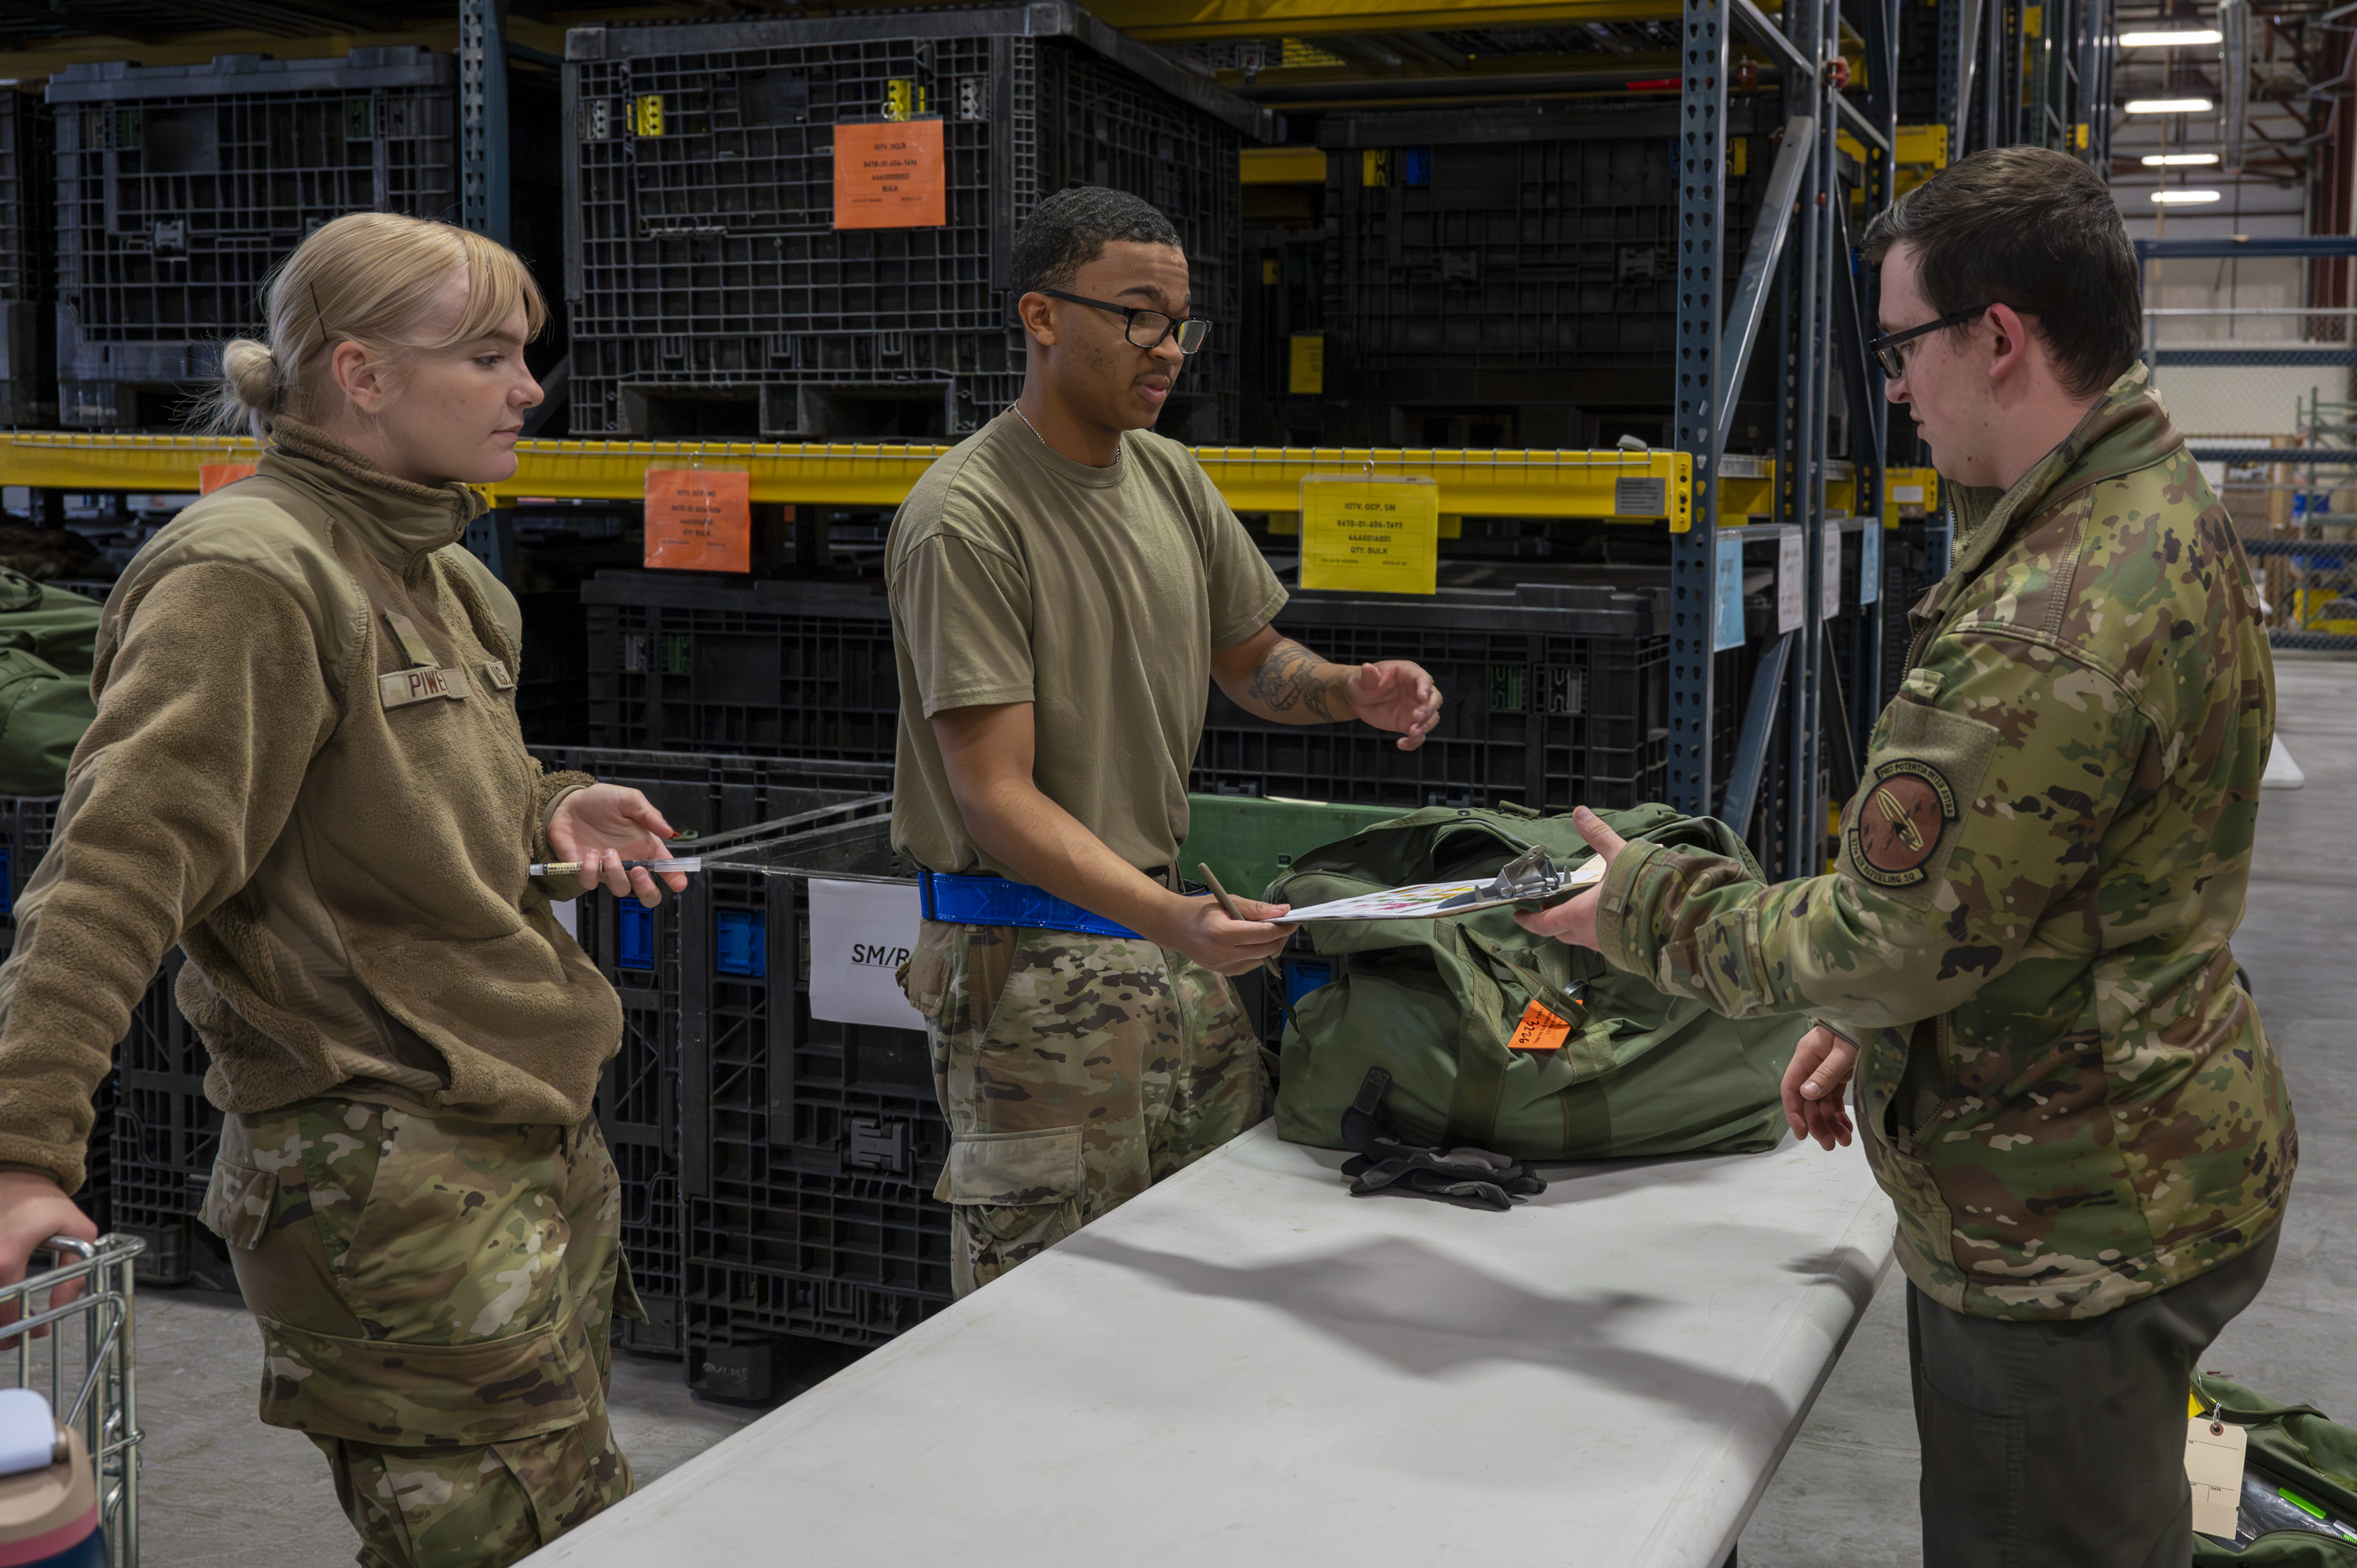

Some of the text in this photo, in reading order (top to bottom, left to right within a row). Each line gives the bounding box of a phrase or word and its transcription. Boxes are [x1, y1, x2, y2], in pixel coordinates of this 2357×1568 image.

[1895, 762, 1927, 775] POTENTIA
[1926, 770, 1945, 789] INTER
[1864, 865, 1901, 883] REFUELING
[1904, 872, 1915, 882] SQ
